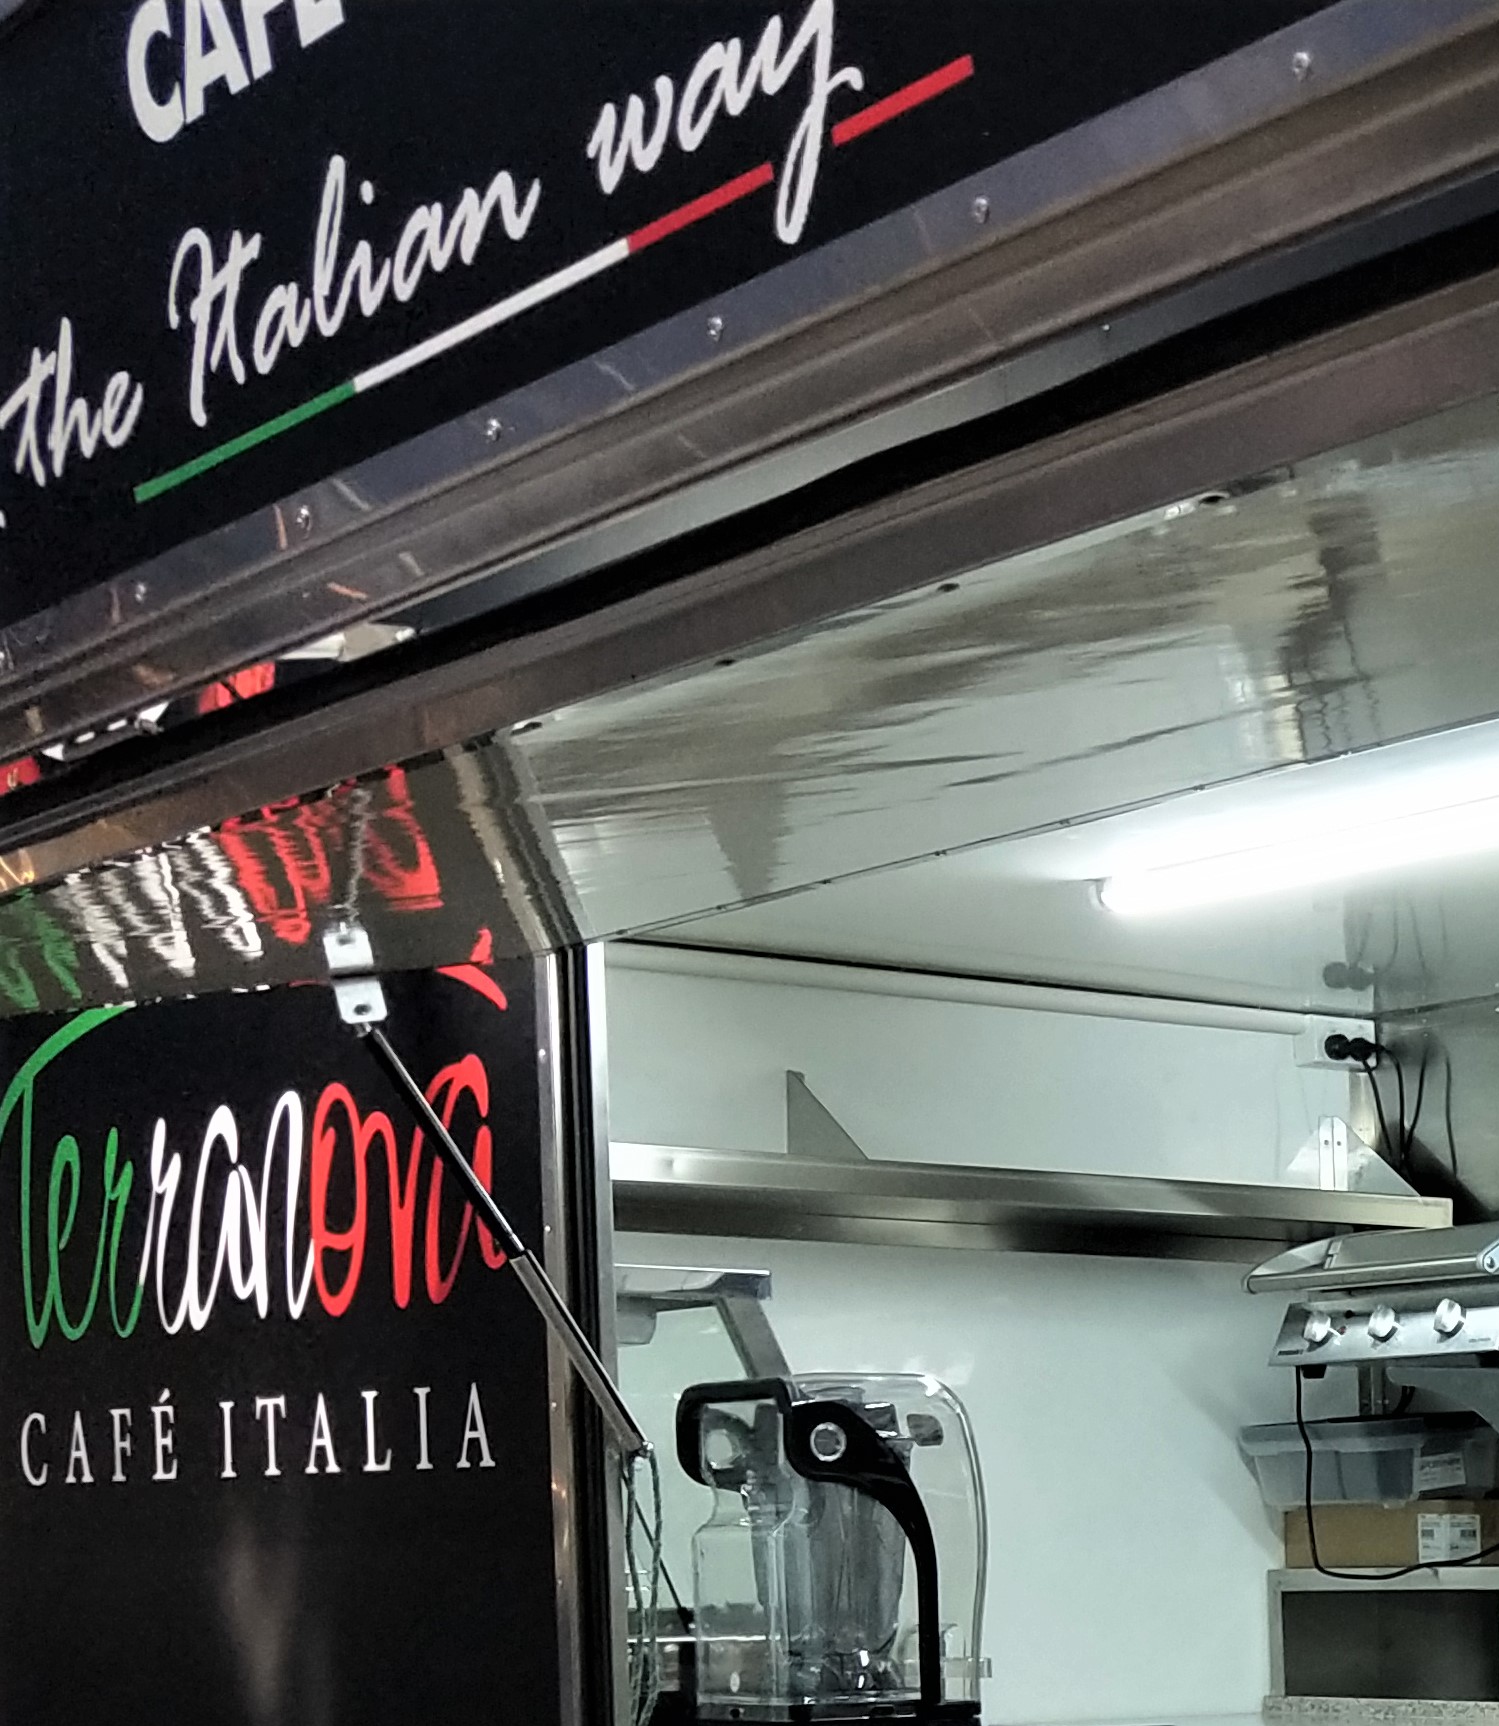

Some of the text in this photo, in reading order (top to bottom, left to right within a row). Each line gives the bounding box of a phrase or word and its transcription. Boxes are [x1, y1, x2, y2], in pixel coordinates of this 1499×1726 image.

[0, 0, 864, 487] the Italian way
[20, 1382, 496, 1487] CAFÉ ITALIA
